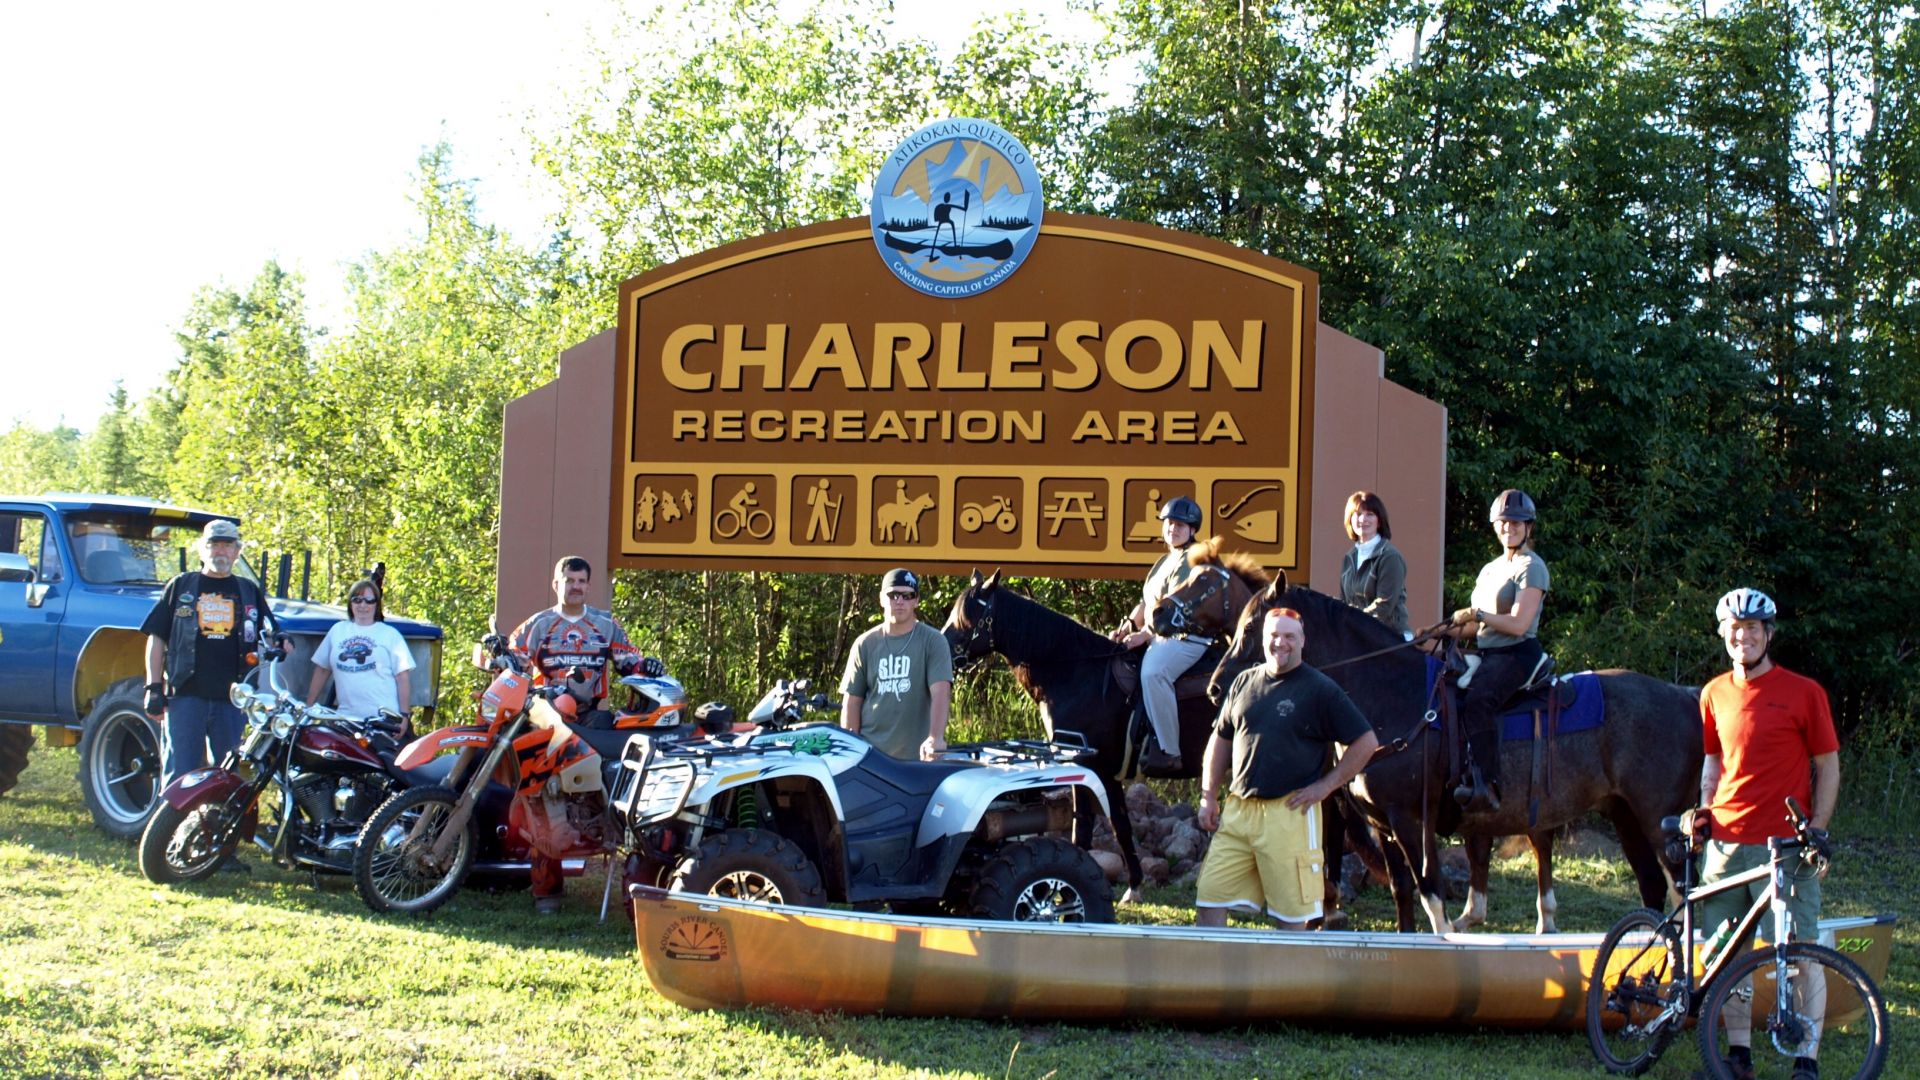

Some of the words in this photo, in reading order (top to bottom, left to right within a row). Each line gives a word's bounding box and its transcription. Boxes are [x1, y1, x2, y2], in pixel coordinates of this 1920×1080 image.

[894, 122, 1026, 167] ATIKOKAN-QUETICO
[893, 260, 934, 292] CANOEING
[934, 284, 970, 295] CAPITAL
[971, 281, 983, 292] OF
[983, 260, 1017, 286] CANADA
[661, 319, 1266, 391] CHARLESON
[672, 409, 1045, 442] RECREATION
[1071, 410, 1247, 445] AREA
[878, 653, 911, 680] SLED
[680, 913, 708, 925] RIVER
